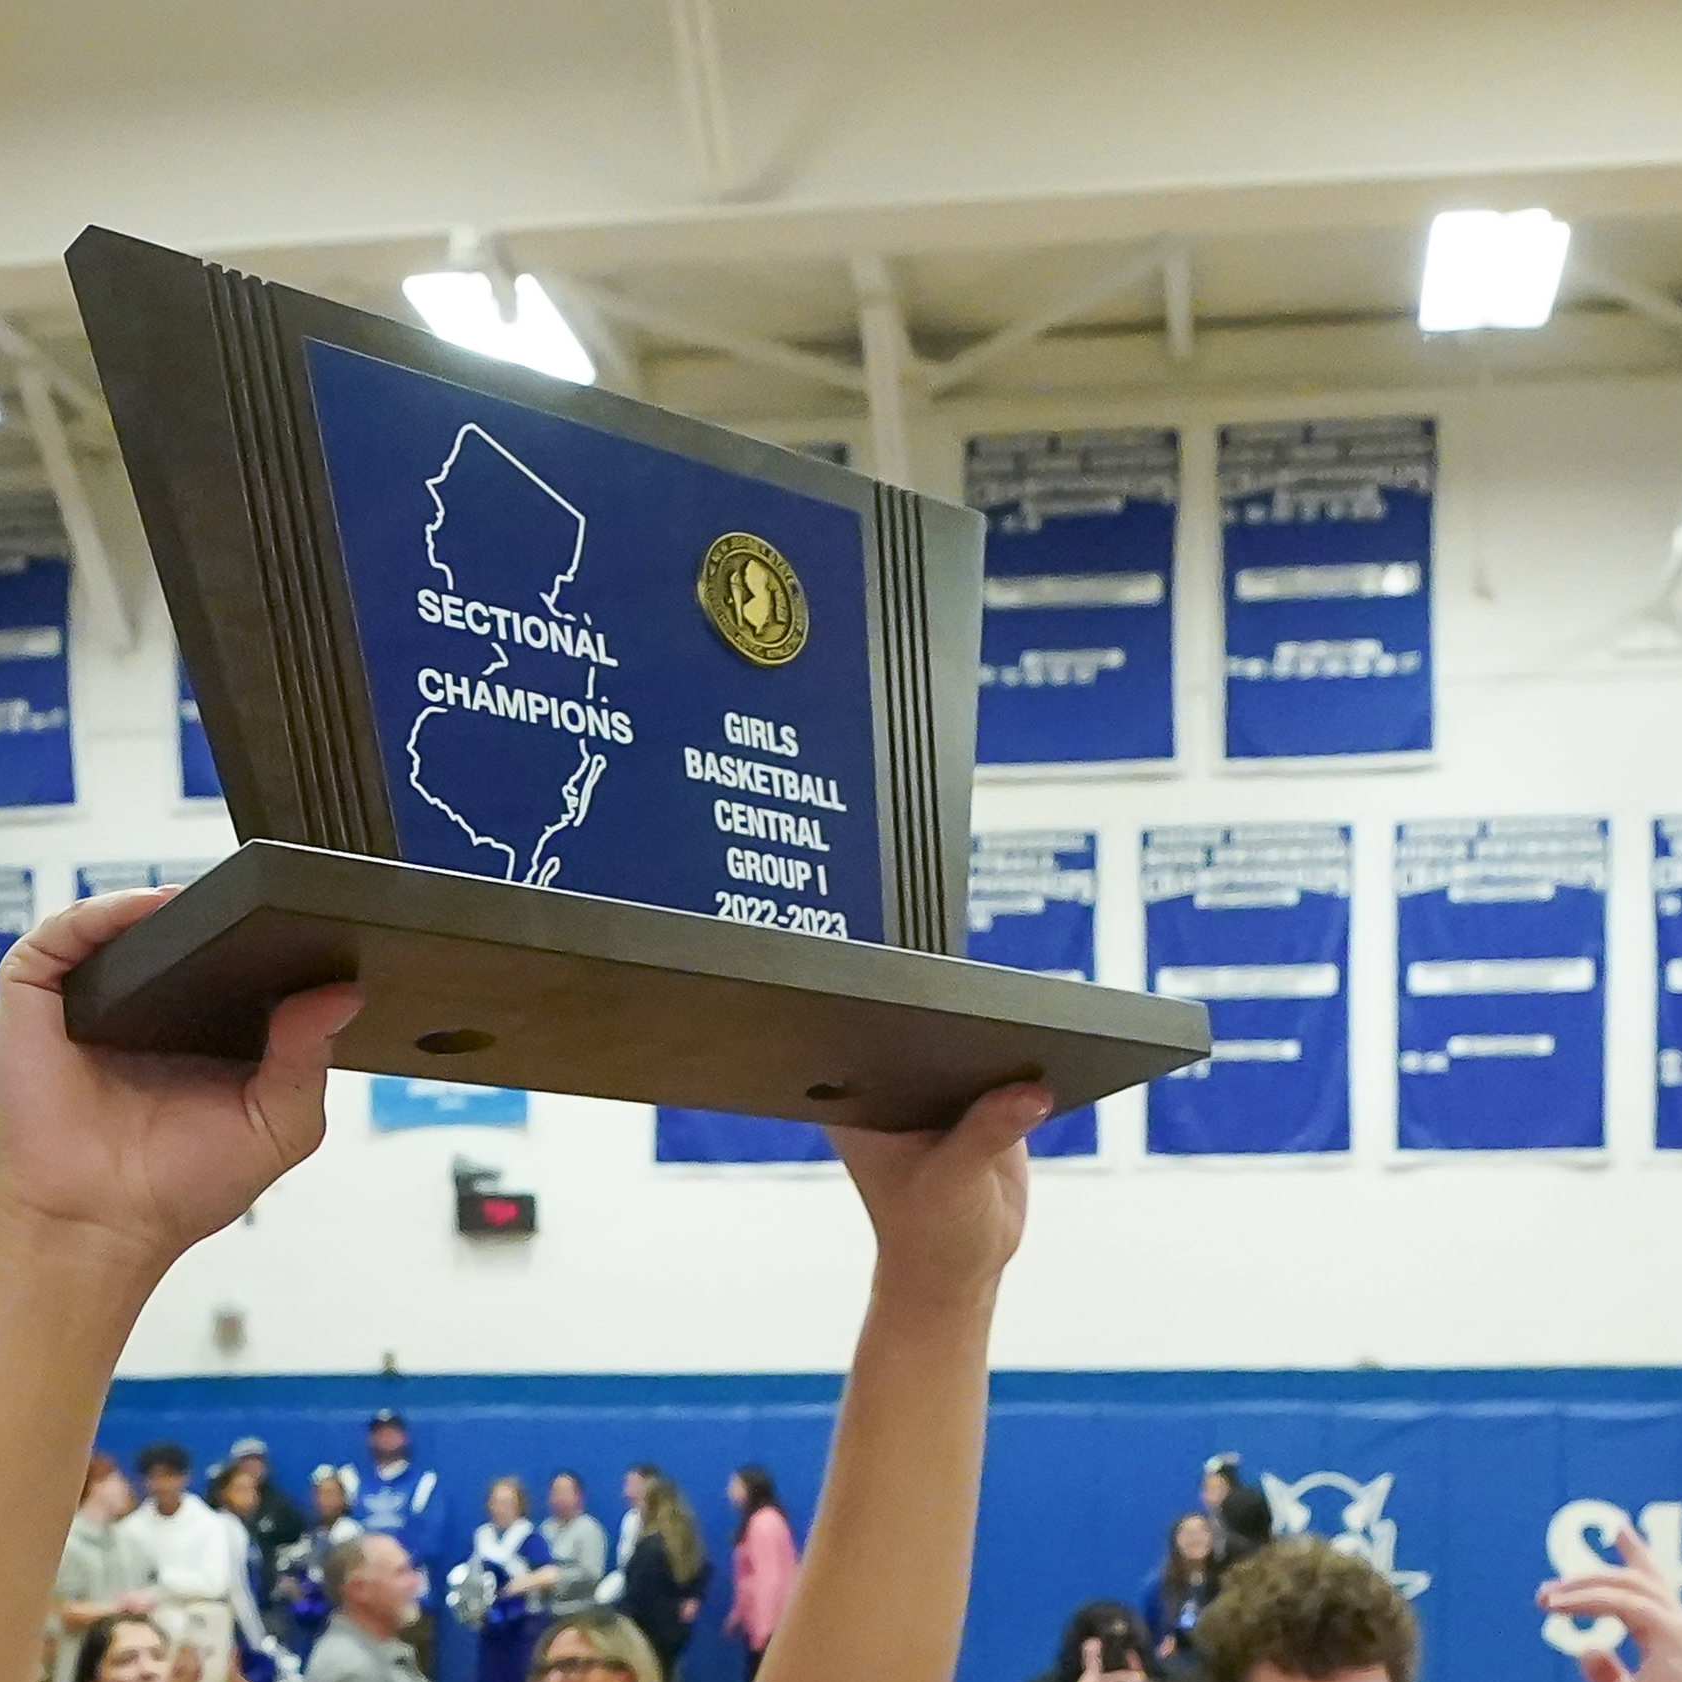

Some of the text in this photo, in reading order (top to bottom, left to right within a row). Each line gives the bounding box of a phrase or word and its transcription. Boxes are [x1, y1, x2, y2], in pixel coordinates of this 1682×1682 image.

[417, 588, 619, 668] SECTIONAL
[418, 668, 634, 745] CHAMPIONS
[723, 711, 799, 757] GIRLS
[684, 746, 847, 812] BASKETBALL
[714, 799, 830, 851] CENTRAL
[726, 846, 828, 896] GROUP I
[715, 891, 848, 940] 2022-2023
